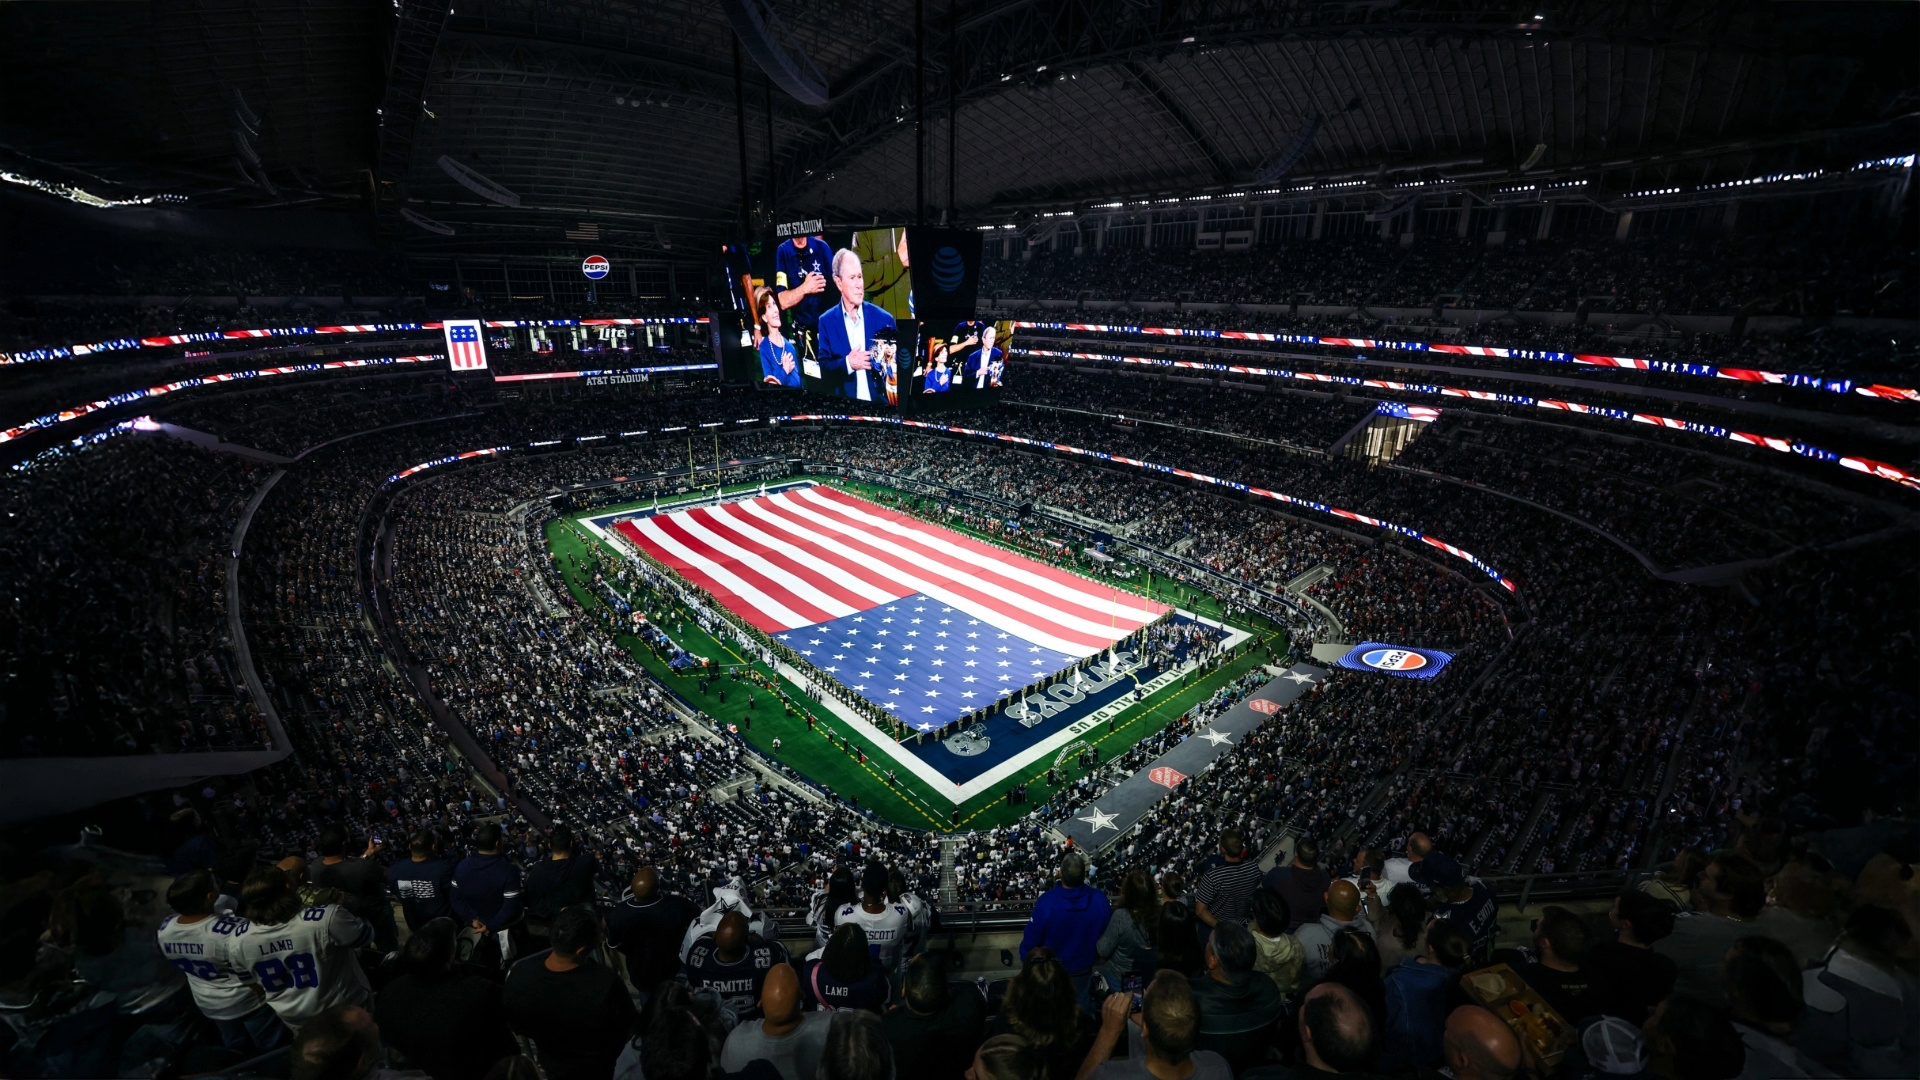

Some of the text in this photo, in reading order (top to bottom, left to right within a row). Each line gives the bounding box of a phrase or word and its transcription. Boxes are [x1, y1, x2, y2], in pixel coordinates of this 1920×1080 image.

[776, 218, 824, 237] AT&T STADIUM
[598, 327, 628, 341] Lite
[586, 373, 649, 386] AT&T STADIUM
[1380, 651, 1407, 669] PEPSI
[1107, 697, 1133, 711] ALL
[1091, 711, 1110, 723] OF
[1069, 721, 1091, 734] US
[866, 931, 895, 941] SCOTT
[164, 943, 204, 956] WITTEN
[259, 940, 294, 956] LAMB
[253, 952, 319, 993] 88
[825, 984, 849, 997] LAMB
